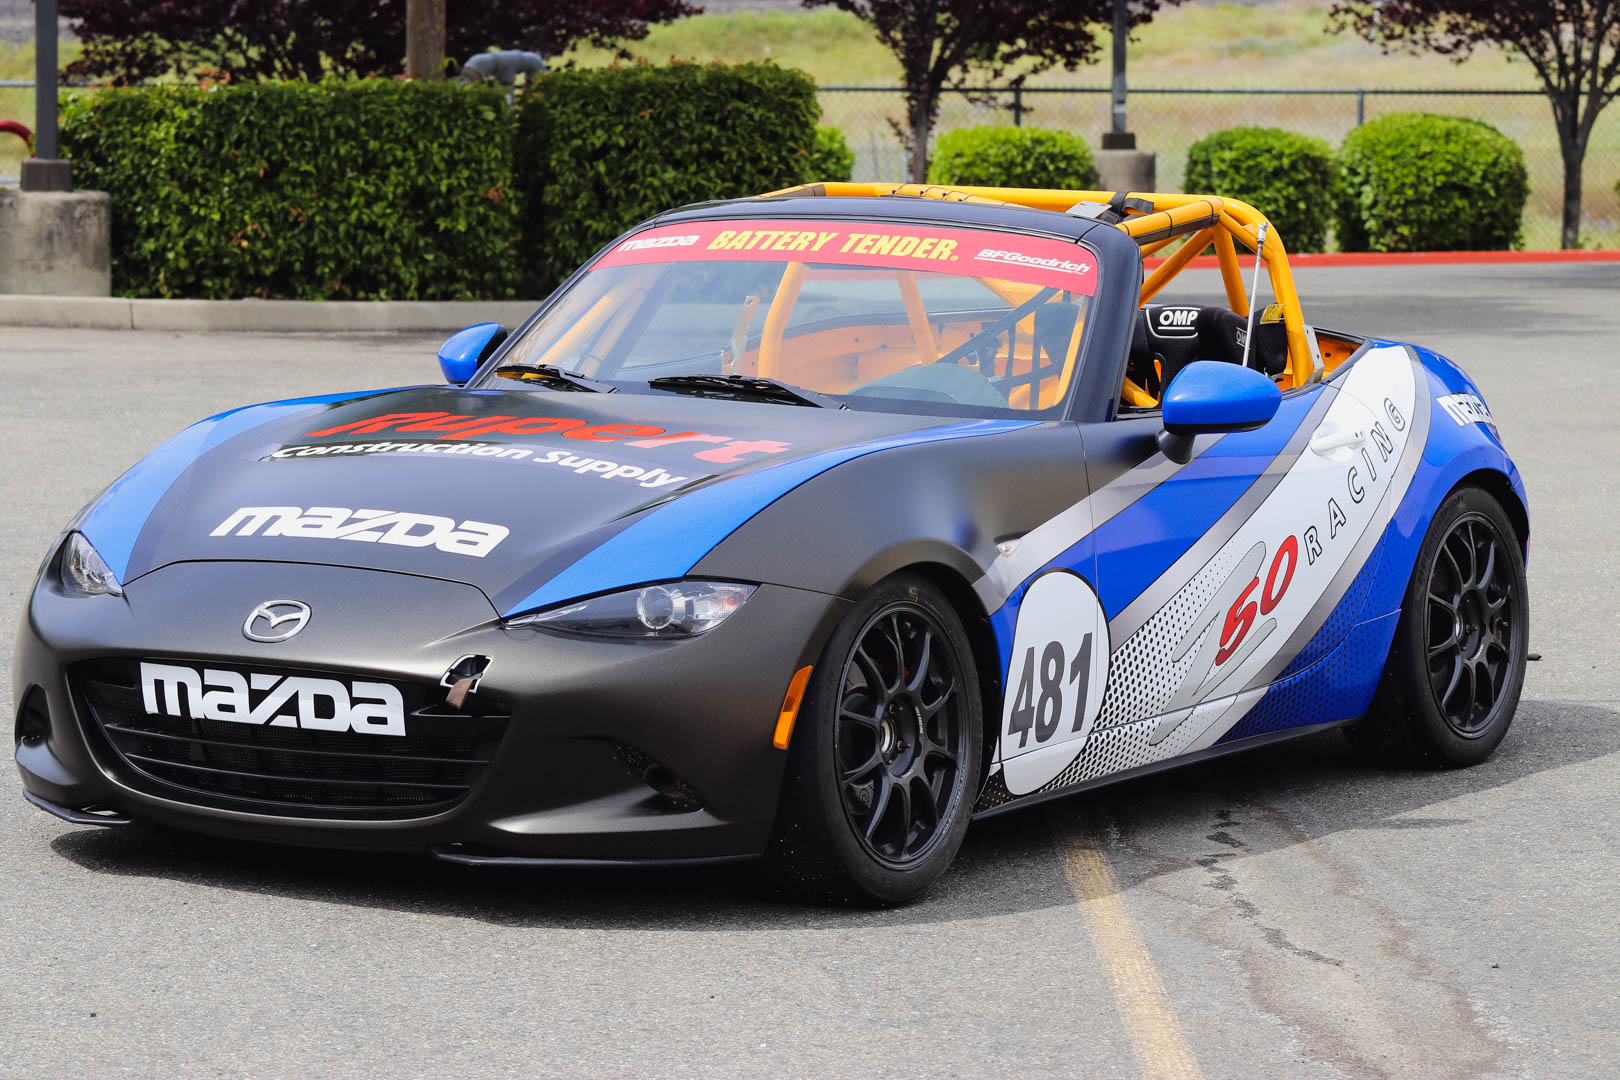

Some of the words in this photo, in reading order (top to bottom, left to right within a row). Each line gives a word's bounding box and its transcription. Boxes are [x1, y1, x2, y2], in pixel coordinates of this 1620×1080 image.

[706, 230, 839, 252] BATTERY
[976, 248, 1092, 273] BFGoodrich
[1159, 310, 1198, 326] OMP
[271, 440, 535, 461] Construction
[536, 450, 689, 488] Supply
[1303, 397, 1406, 566] RACING
[1008, 632, 1093, 750] 481
